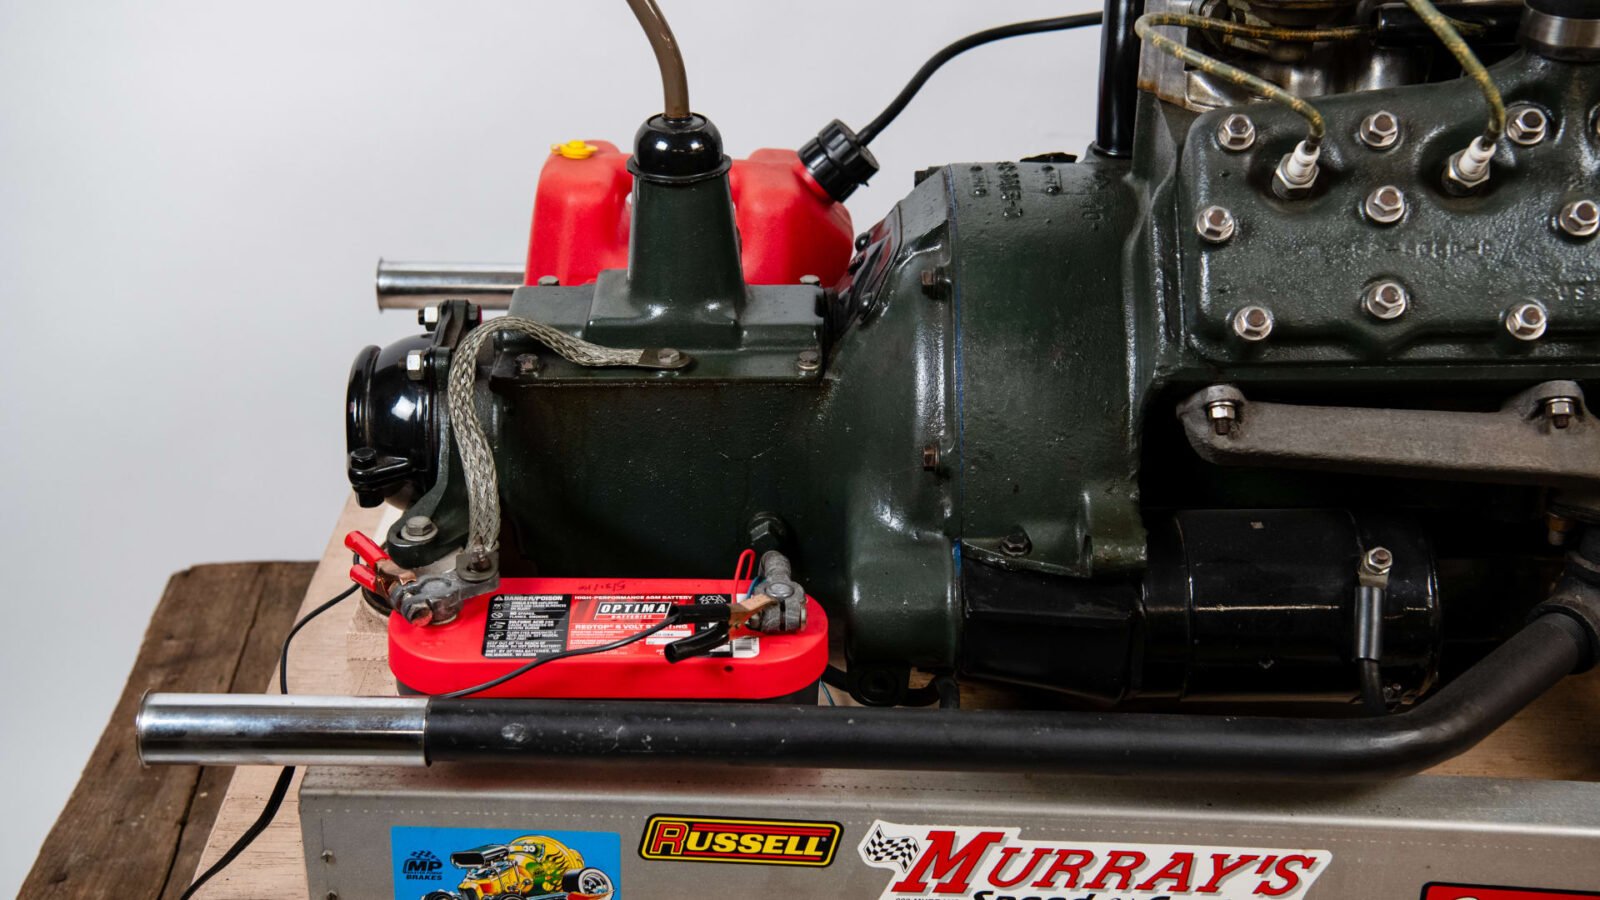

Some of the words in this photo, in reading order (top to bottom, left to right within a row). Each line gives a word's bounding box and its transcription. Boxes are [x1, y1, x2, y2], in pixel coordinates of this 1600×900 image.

[600, 603, 666, 613] OPTIMA
[651, 822, 825, 856] RUSSELL
[407, 860, 443, 871] MP
[891, 830, 1318, 897] MURRAY'S
